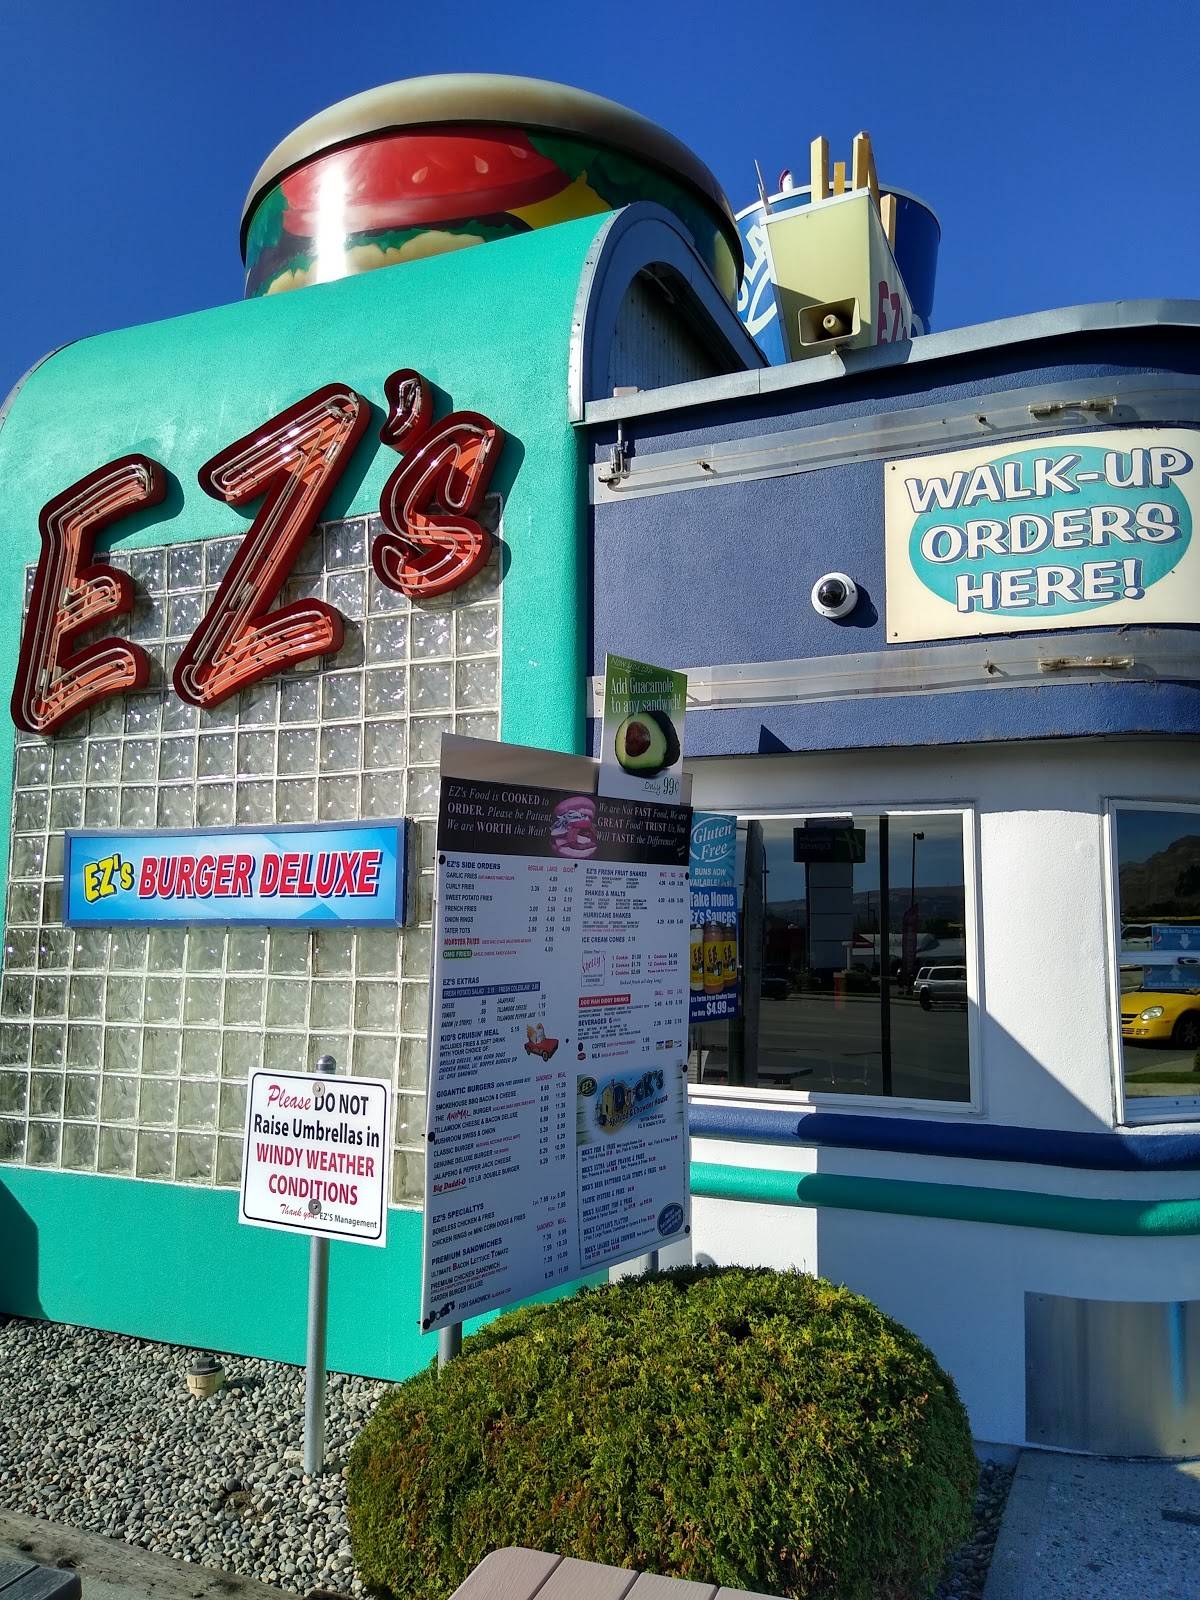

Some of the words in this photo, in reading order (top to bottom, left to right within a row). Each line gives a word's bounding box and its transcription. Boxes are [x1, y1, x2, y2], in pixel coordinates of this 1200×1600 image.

[904, 447, 1194, 513] WALK-UP
[919, 502, 1183, 563] ORDERS
[10, 368, 505, 736] EZ's
[956, 558, 1145, 613] HERE!
[611, 677, 627, 694] Add
[630, 677, 673, 694] Guacamole
[611, 697, 620, 712] to
[624, 700, 639, 716] any
[448, 785, 466, 797] EZ's
[469, 788, 491, 800] Food
[502, 792, 539, 805] COOKED
[663, 777, 679, 795] 99¢
[448, 802, 484, 816] ORDER.
[488, 807, 513, 818] Please
[515, 809, 525, 819] be
[599, 803, 608, 811] We
[622, 806, 633, 815] Not
[635, 807, 652, 817] FAST
[447, 819, 458, 830] We
[477, 822, 511, 834] WORTH
[514, 825, 525, 835] the
[528, 826, 546, 837] Wait!
[598, 817, 623, 828] GREAT
[645, 822, 666, 832] TRUST
[597, 831, 609, 841] Will
[612, 832, 634, 843] TASTE
[637, 835, 646, 844] the
[694, 825, 732, 843] Gluten
[701, 843, 727, 860] Free
[82, 854, 135, 905] EZ's
[137, 853, 255, 899] BURGER
[259, 849, 384, 898] DELUXE
[689, 892, 709, 907] Take
[711, 892, 734, 907] Home
[706, 909, 736, 923] Sauces
[707, 1001, 726, 1016] $4.99
[484, 1028, 499, 1036] MEAL
[437, 1087, 466, 1098] GIGANTIC
[468, 1082, 495, 1092] BURGERS
[267, 1084, 311, 1111] Please
[314, 1092, 335, 1112] DO
[339, 1094, 368, 1116] NOT
[254, 1114, 288, 1136] Raise
[293, 1118, 363, 1145] Umbrellas
[367, 1126, 379, 1147] in
[256, 1143, 303, 1167] WINDY
[307, 1149, 374, 1177] WEATHER
[269, 1174, 358, 1206] CONDITIONS
[280, 1203, 301, 1217] Thank
[319, 1212, 333, 1221] EZ'S
[335, 1215, 377, 1229] Management
[433, 1214, 446, 1223] EZ'S
[432, 1250, 460, 1265] PREMIUM
[462, 1237, 502, 1256] SANDWICHES
